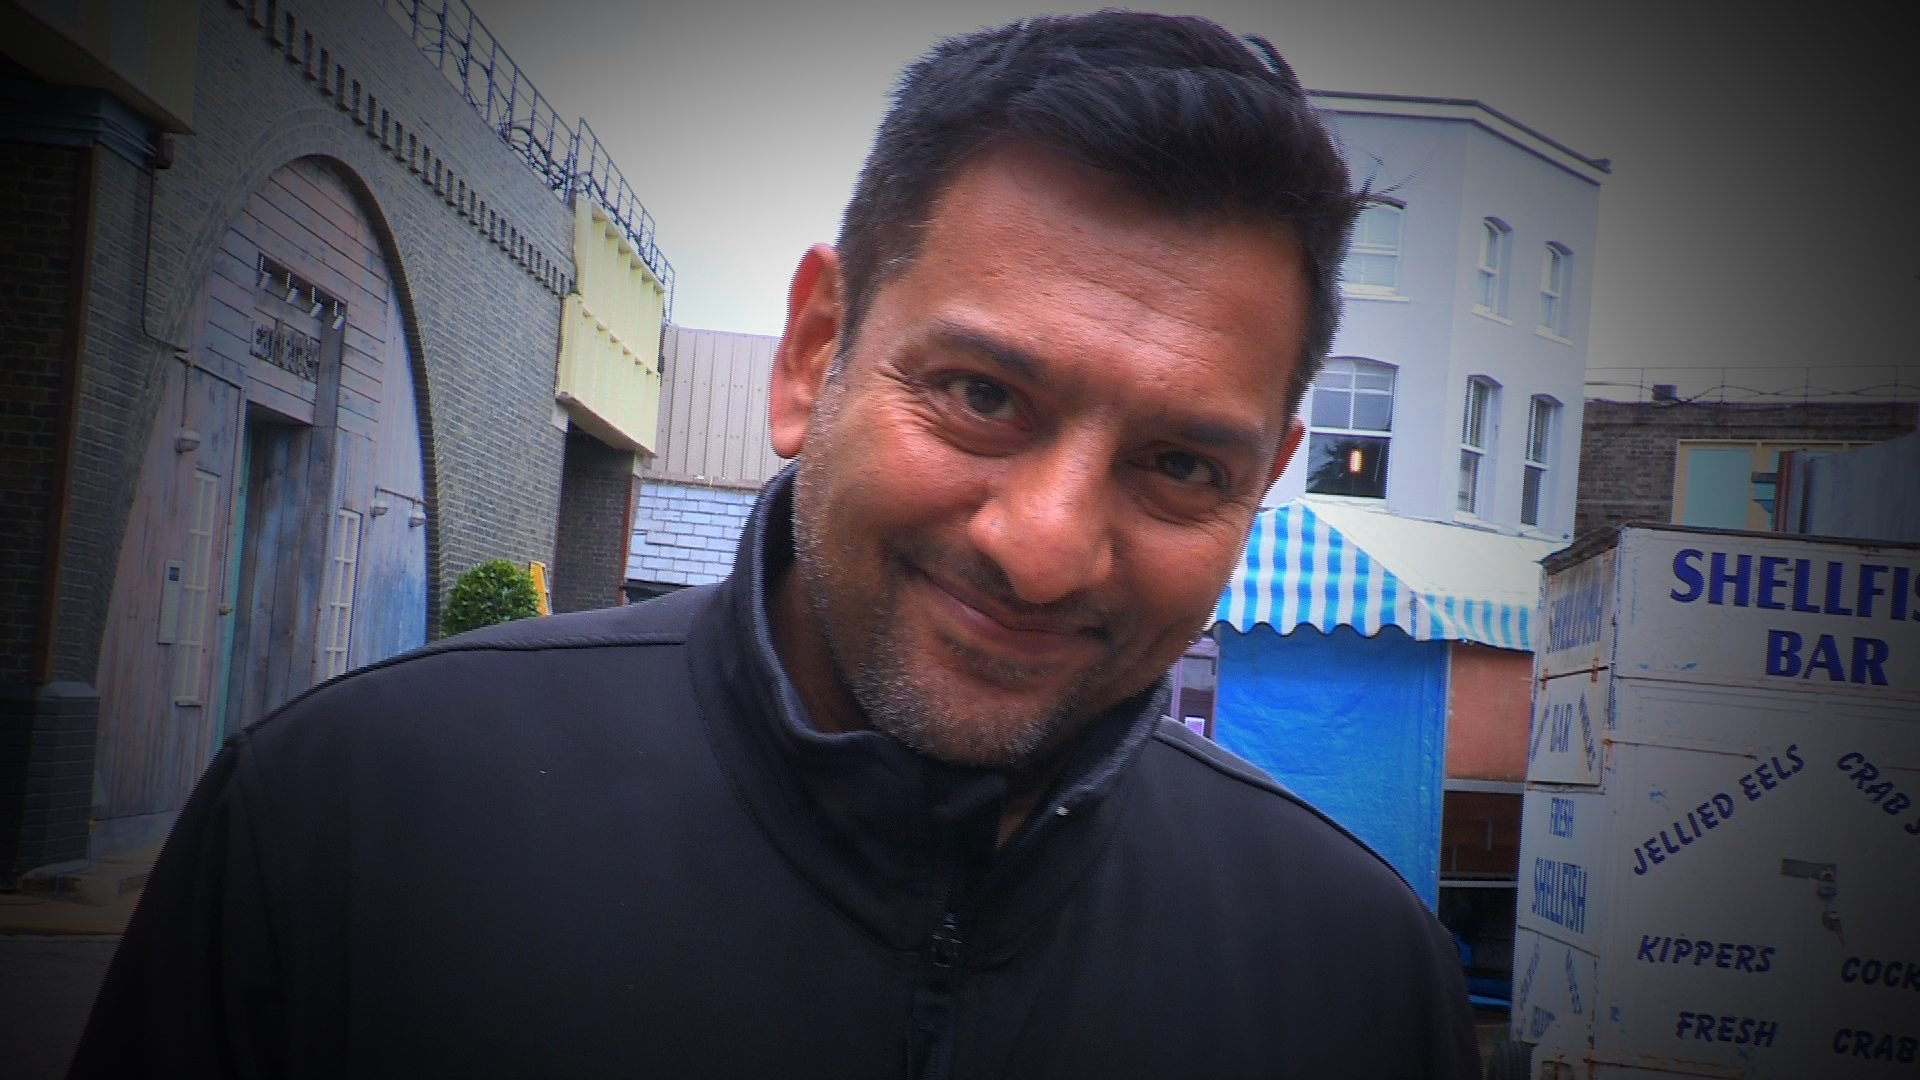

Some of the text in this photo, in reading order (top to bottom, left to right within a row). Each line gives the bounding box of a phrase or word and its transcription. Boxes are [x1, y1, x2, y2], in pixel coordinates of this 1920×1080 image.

[1546, 584, 1604, 654] SHELLFISH
[1765, 629, 1890, 686] BAR
[1549, 703, 1573, 752] BAR
[1549, 797, 1575, 839] FRESH
[1633, 743, 1804, 876] JELLIED EELS
[1532, 857, 1587, 934] SHELLFISH
[1637, 934, 1776, 973] KIPPERS
[1676, 1010, 1778, 1048] FRESH
